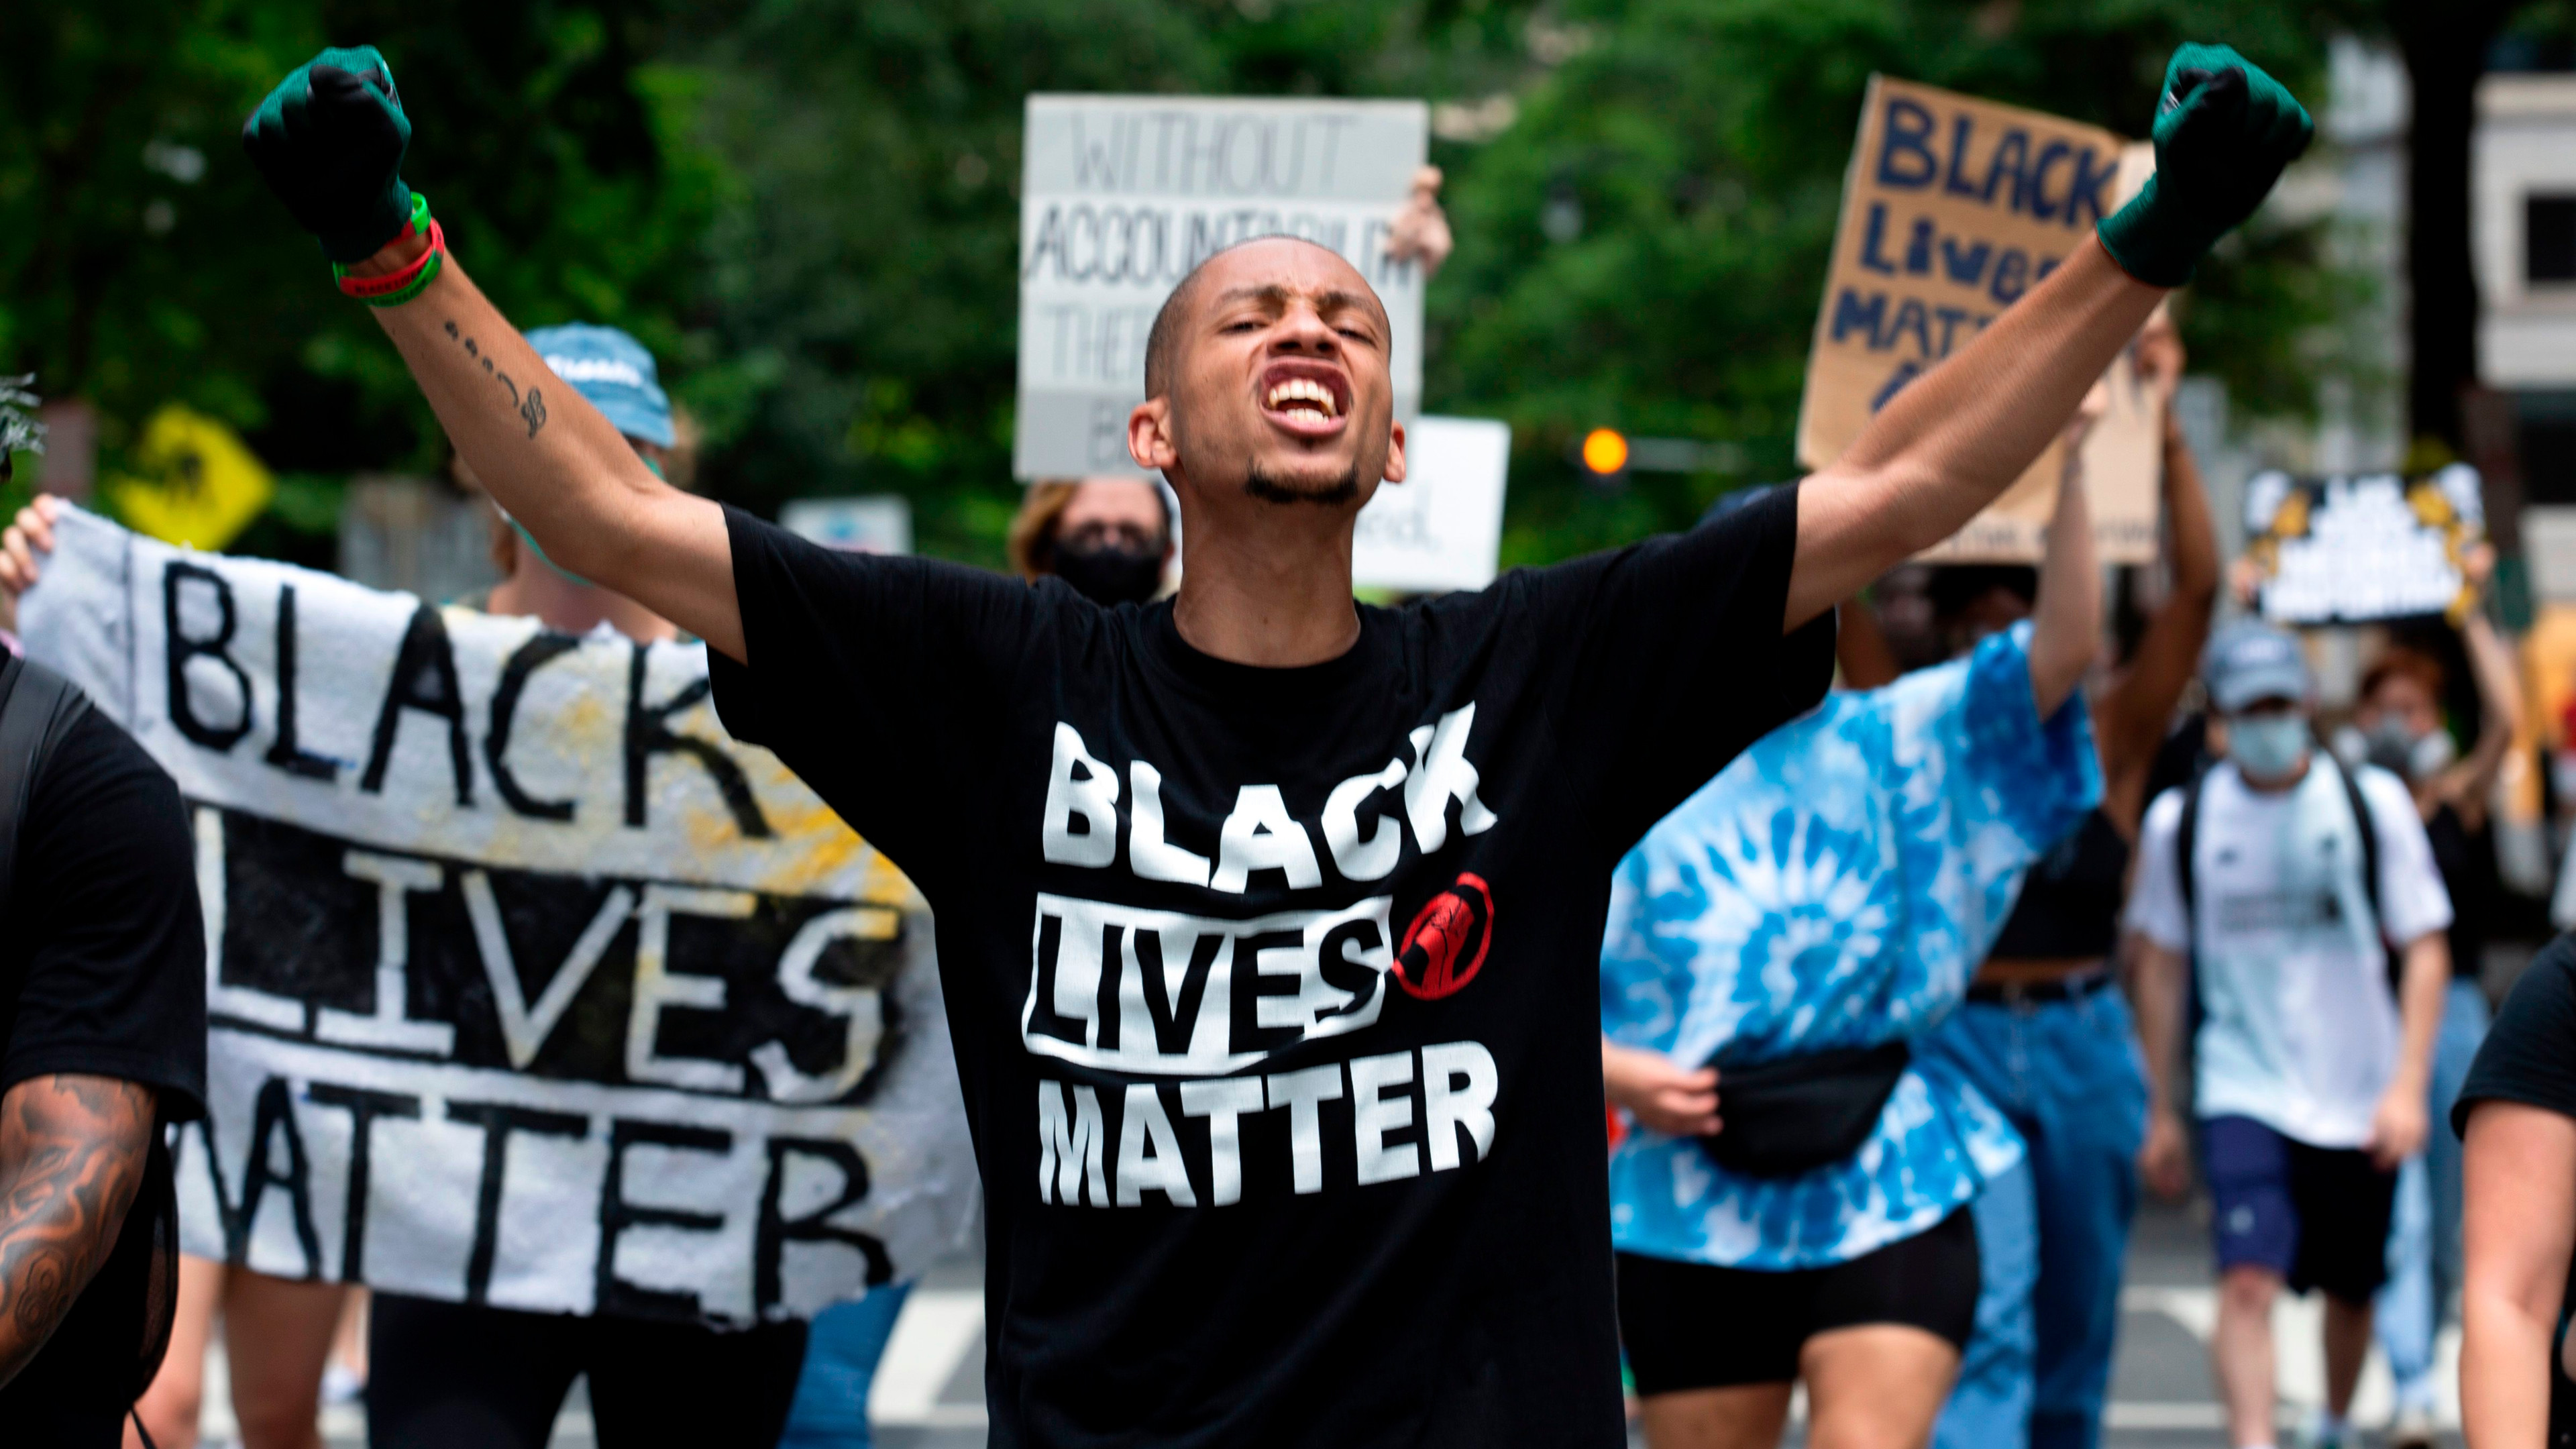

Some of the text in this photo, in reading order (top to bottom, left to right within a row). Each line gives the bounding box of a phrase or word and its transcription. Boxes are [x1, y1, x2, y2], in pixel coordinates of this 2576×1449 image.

[1071, 109, 1359, 197] WITHOUT
[1874, 95, 2118, 229] BLACK
[163, 559, 775, 840] BLACK
[1042, 700, 1498, 894] BLACK
[193, 807, 900, 1102] LIVES
[1026, 909, 1386, 1059] LIVES
[1038, 1040, 1499, 1208] MATTER
